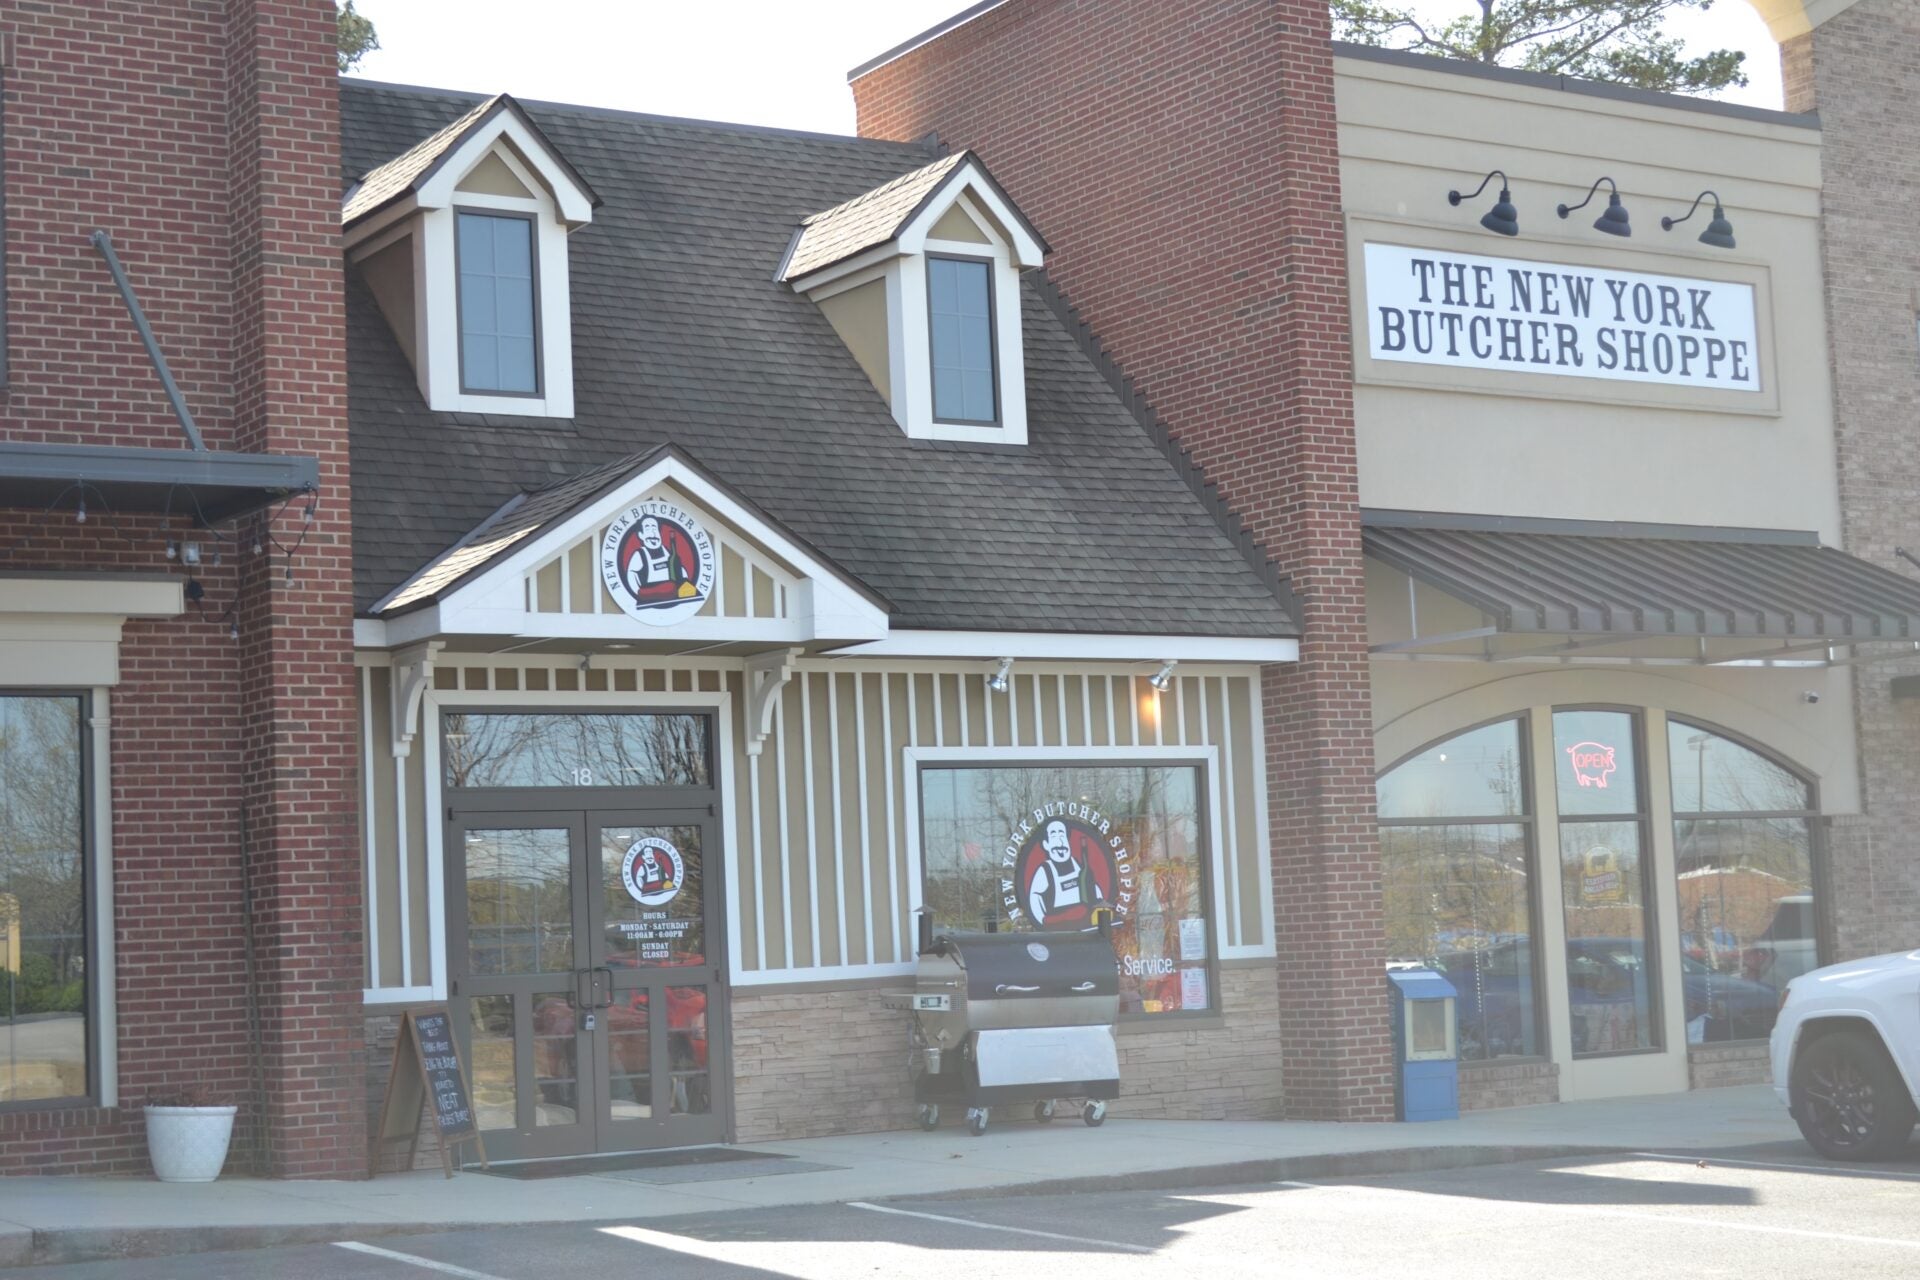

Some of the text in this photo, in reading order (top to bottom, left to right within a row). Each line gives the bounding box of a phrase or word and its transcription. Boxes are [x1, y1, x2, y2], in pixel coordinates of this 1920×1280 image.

[1411, 258, 1715, 331] THE NEW YORK
[1378, 306, 1750, 381] BUTCHER SHOPPE
[605, 503, 712, 592] NEW YORK BUTCHER SHOPPE
[1575, 753, 1610, 769] OPEN
[571, 768, 592, 786] 18
[1001, 801, 1132, 921] NEW YORK BUTCHER SHOPPE
[643, 912, 666, 920] HOURS
[620, 923, 648, 931] MONDAY
[652, 922, 689, 930] SATURDAY
[641, 942, 669, 950] SUNDAY
[642, 951, 669, 959] CLOSED
[1123, 955, 1176, 976] Service.
